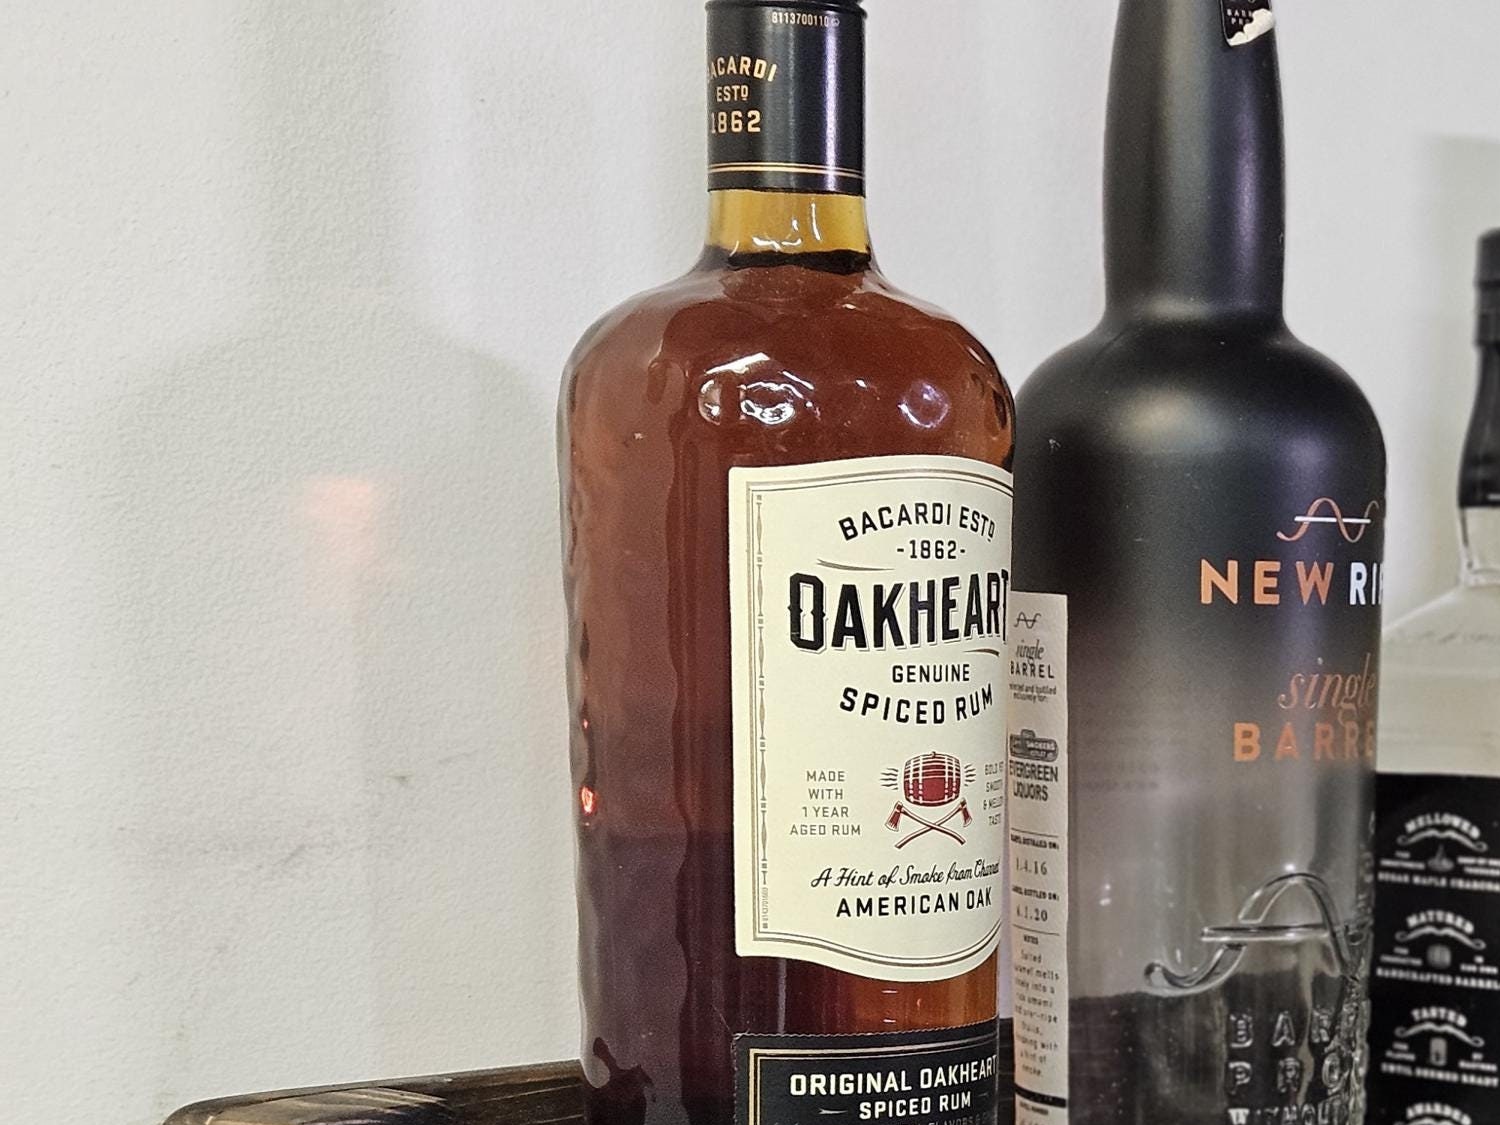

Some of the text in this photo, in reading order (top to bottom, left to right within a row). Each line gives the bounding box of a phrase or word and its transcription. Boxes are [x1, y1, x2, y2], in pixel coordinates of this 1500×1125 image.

[711, 109, 761, 134] 1862
[838, 502, 952, 541] BACARDI
[1199, 558, 1335, 606] NEW
[891, 663, 971, 683] GENUINE
[1010, 660, 1055, 679] BARREL
[839, 683, 993, 725] SPICED RUM
[806, 770, 845, 783] MADE
[808, 788, 844, 800] WITH
[801, 806, 849, 818] 1 YEAR
[789, 824, 861, 836] AGED RUM
[810, 867, 833, 887] A
[833, 867, 874, 887] Hint
[877, 865, 900, 889] of
[899, 864, 945, 885] Smoke
[945, 861, 973, 884] from
[836, 891, 959, 918] AMERICAN
[966, 886, 992, 910] OAK
[1406, 909, 1475, 934] MATURED
[1411, 1005, 1468, 1028] TASTED
[789, 1073, 913, 1096] ORIGINAL
[919, 1054, 999, 1089] OAKHEART
[858, 1090, 972, 1120] SPICED RUM
